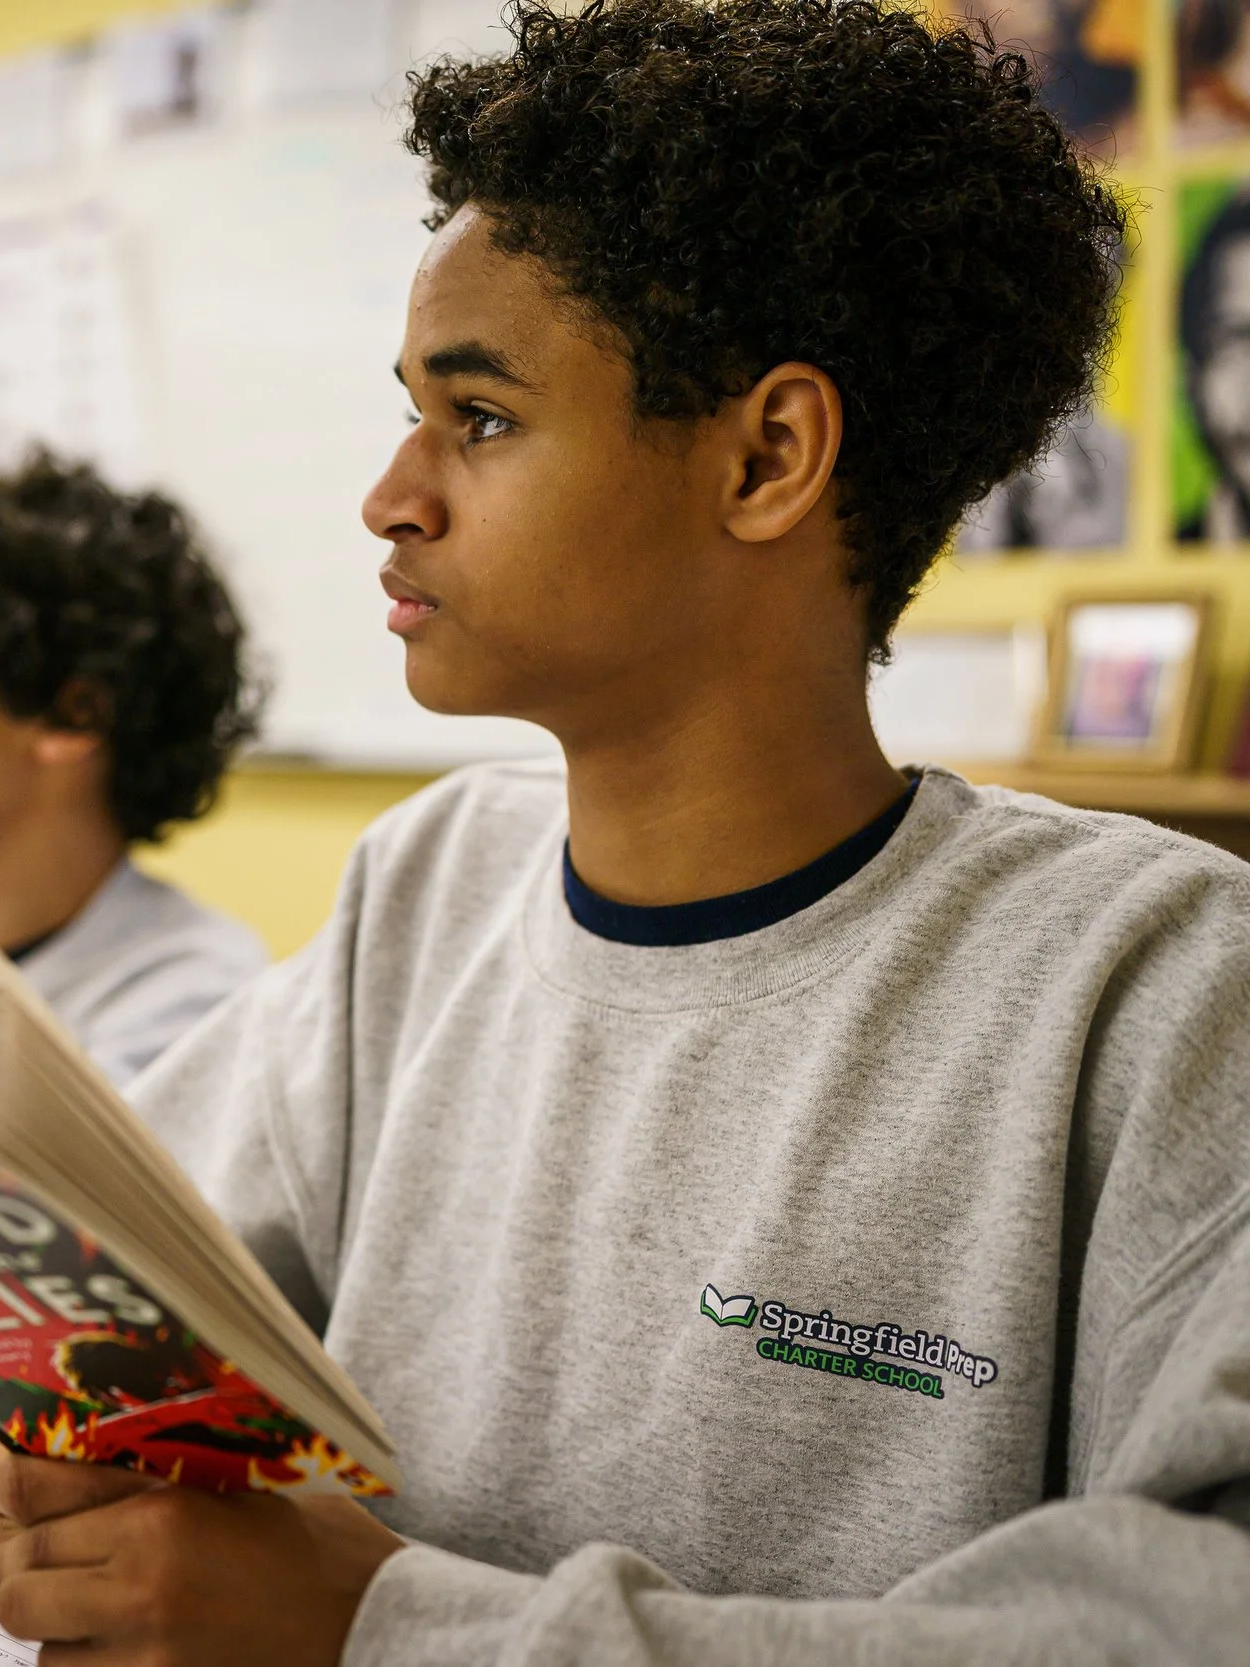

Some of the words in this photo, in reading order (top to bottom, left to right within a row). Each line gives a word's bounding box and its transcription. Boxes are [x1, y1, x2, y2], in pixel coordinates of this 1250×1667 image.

[756, 1337, 858, 1378] CHARTER
[861, 1361, 945, 1399] SCHOOL
[760, 1301, 946, 1370] Springfield
[945, 1341, 997, 1387] Prep
